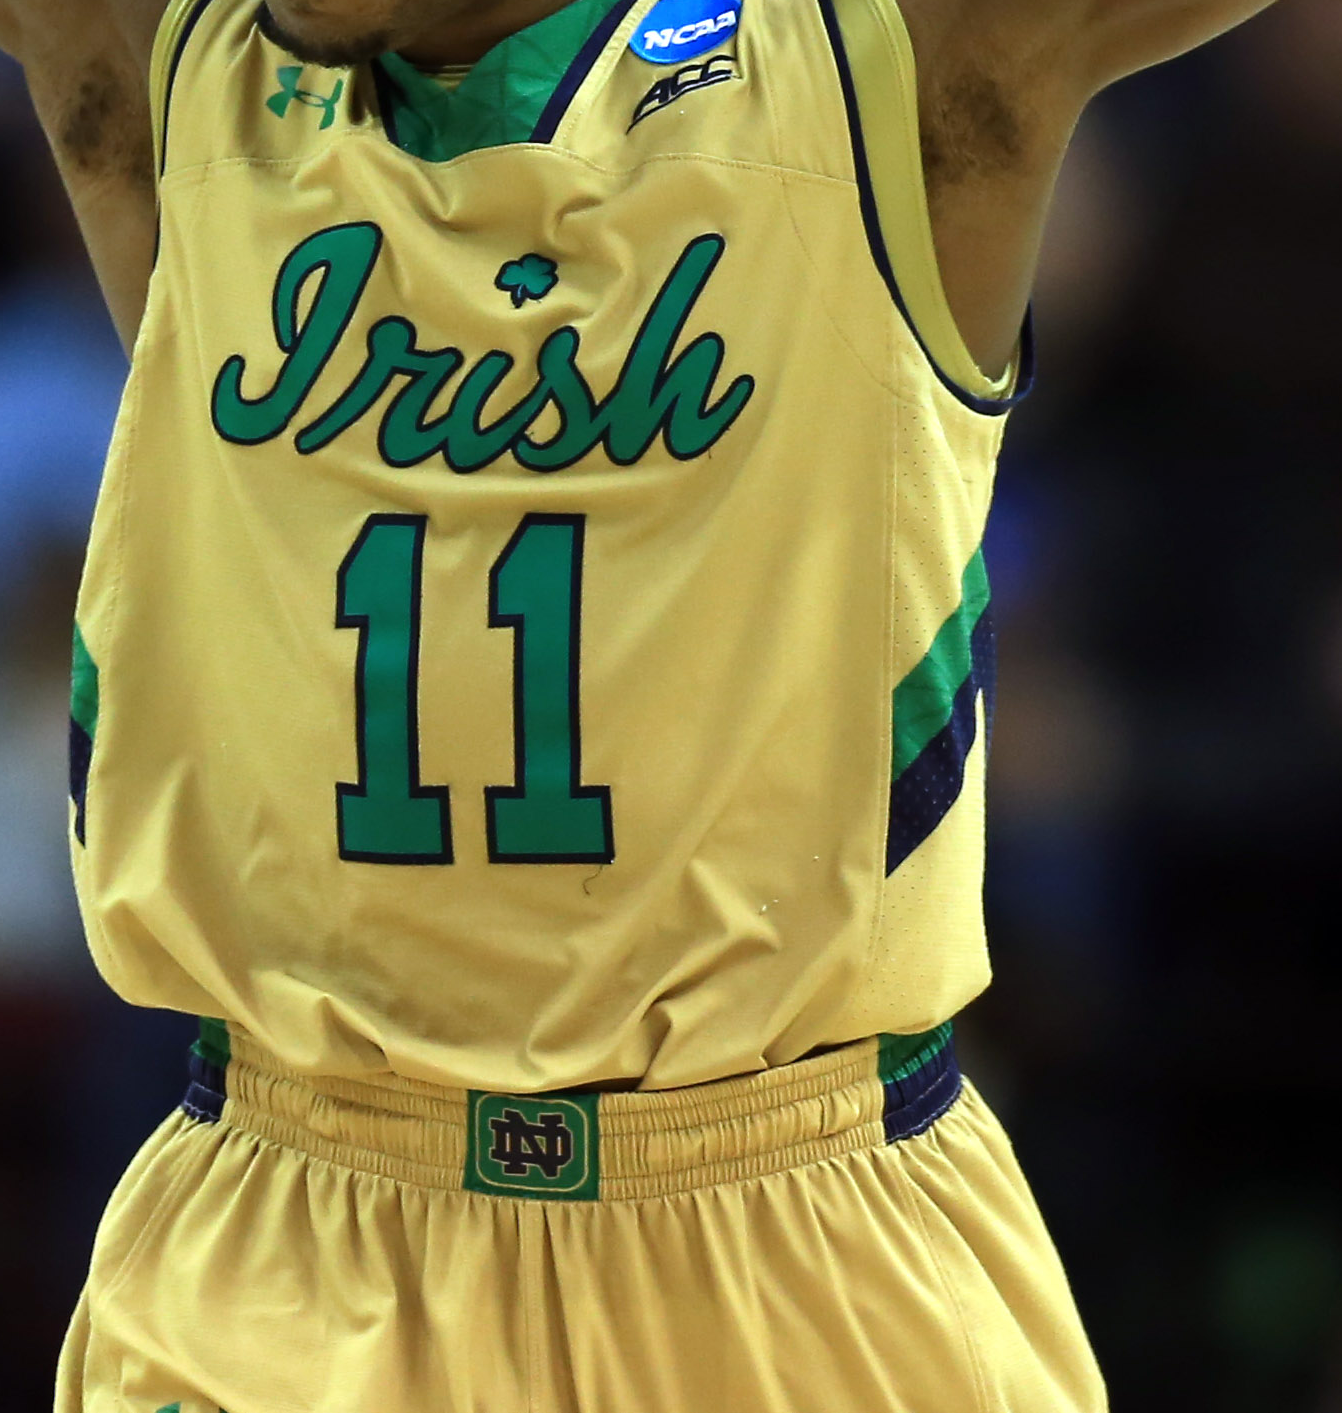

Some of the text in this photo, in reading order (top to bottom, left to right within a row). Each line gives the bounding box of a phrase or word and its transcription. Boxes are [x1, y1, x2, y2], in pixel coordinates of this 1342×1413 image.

[630, 54, 738, 125] ACC
[643, 10, 737, 50] NCAA
[212, 220, 755, 472] Irish
[335, 513, 616, 865] 11
